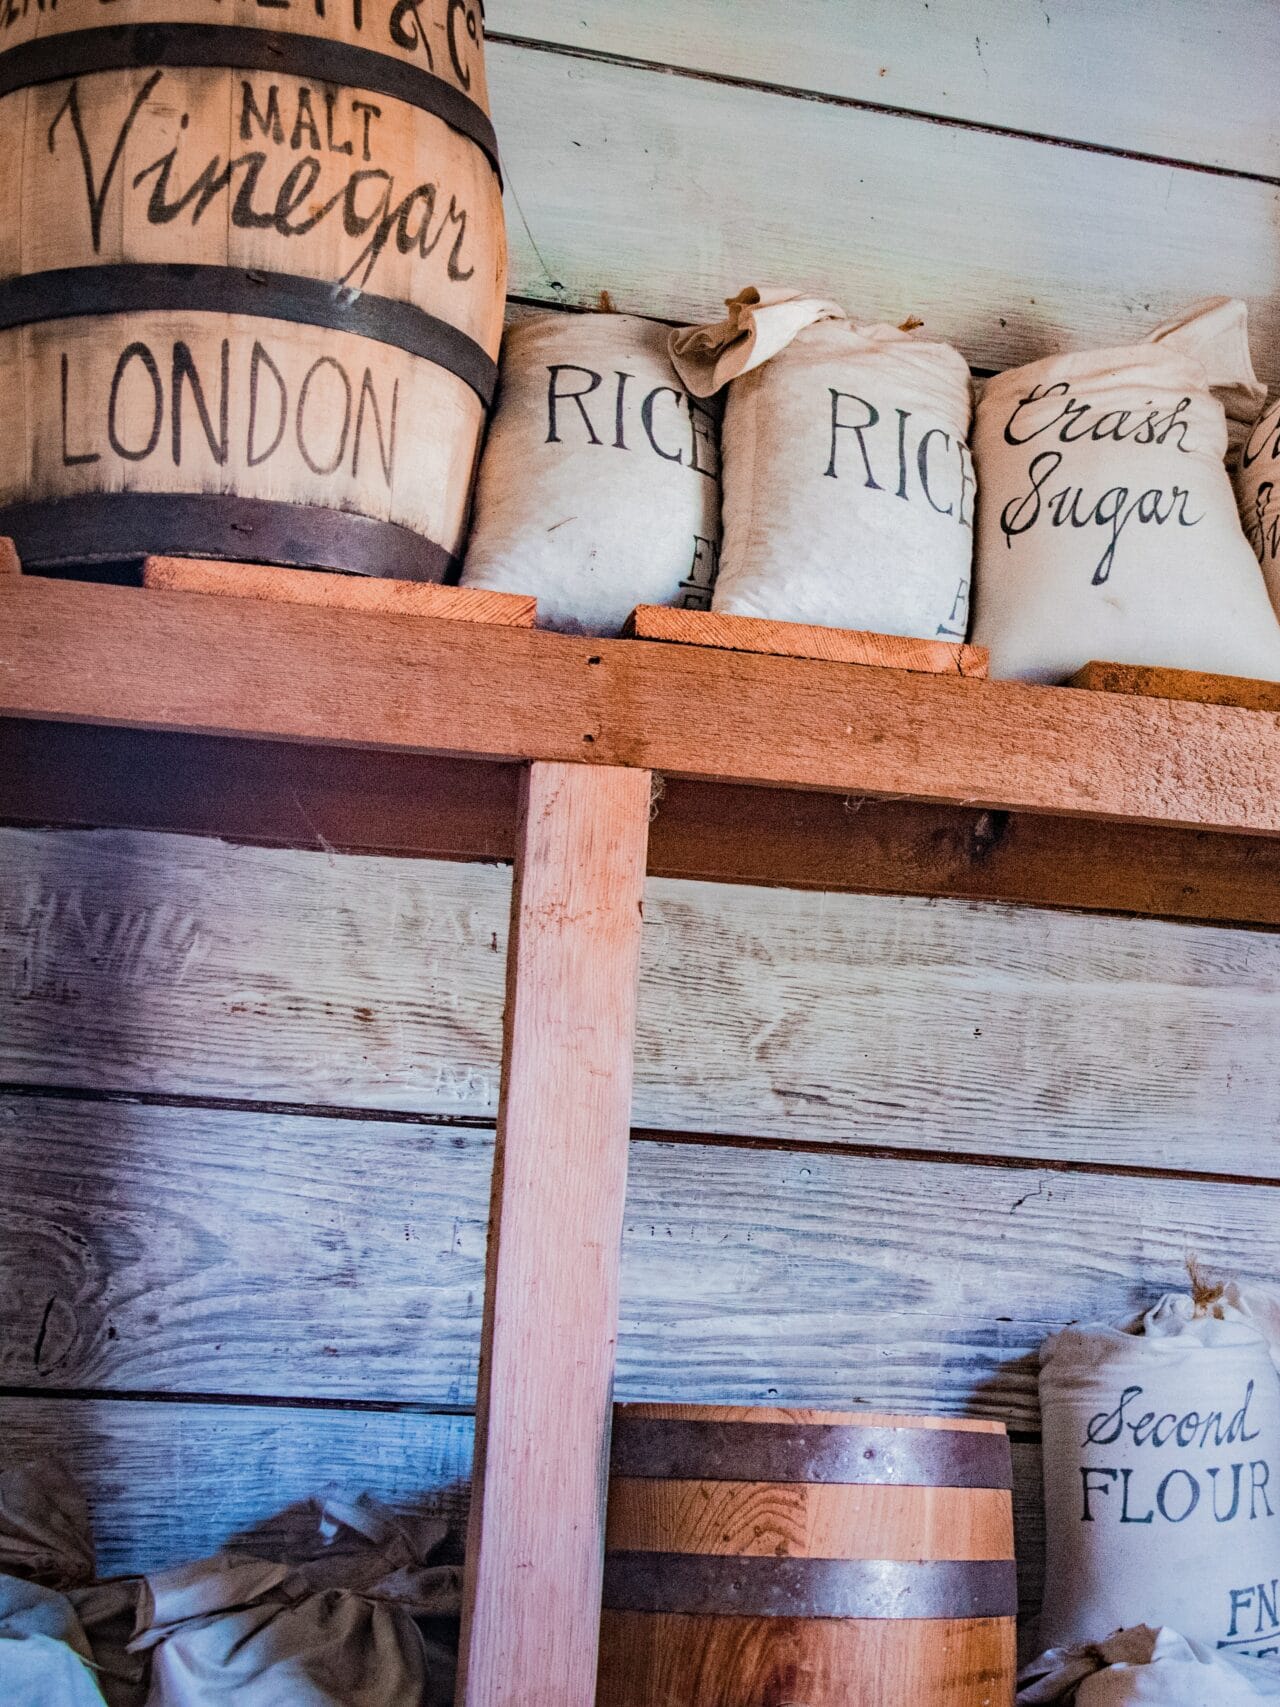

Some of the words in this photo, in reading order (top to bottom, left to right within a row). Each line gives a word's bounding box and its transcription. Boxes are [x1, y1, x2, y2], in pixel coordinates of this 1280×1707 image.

[240, 80, 382, 162] MALT
[48, 69, 476, 286] Vinegar
[61, 338, 400, 488] LONDON
[545, 363, 718, 482] RICE
[822, 387, 976, 529] RICE
[1003, 382, 1203, 454] Crash
[1000, 451, 1207, 586] Sugar
[1081, 1378, 1262, 1450] Second
[1079, 1459, 1276, 1525] FLOUR
[1226, 1578, 1280, 1637] FN
